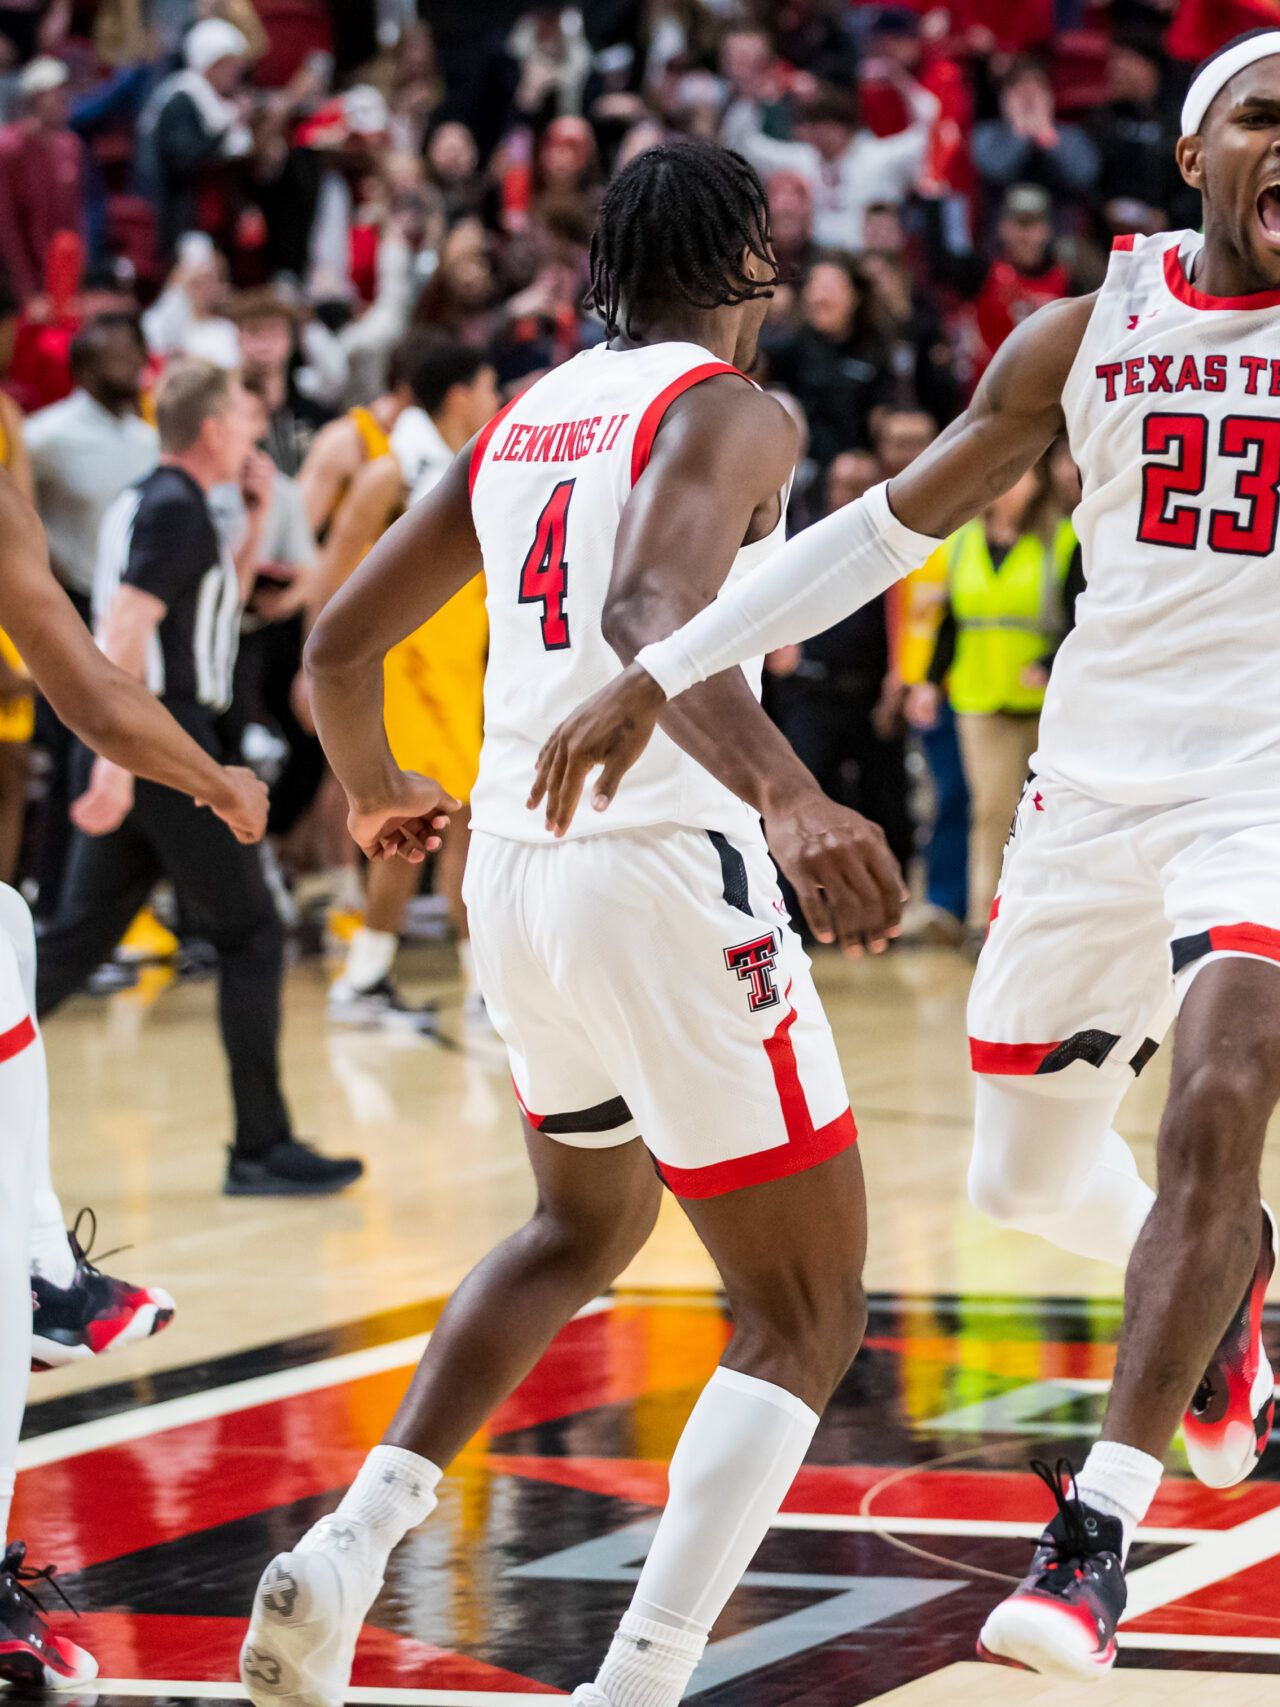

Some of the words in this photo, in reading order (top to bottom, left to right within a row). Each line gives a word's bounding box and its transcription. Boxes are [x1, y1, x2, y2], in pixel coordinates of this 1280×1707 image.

[1096, 355, 1227, 402] TEXAS
[492, 416, 602, 462] JENNINGS
[596, 414, 630, 453] II
[518, 477, 577, 652] 4
